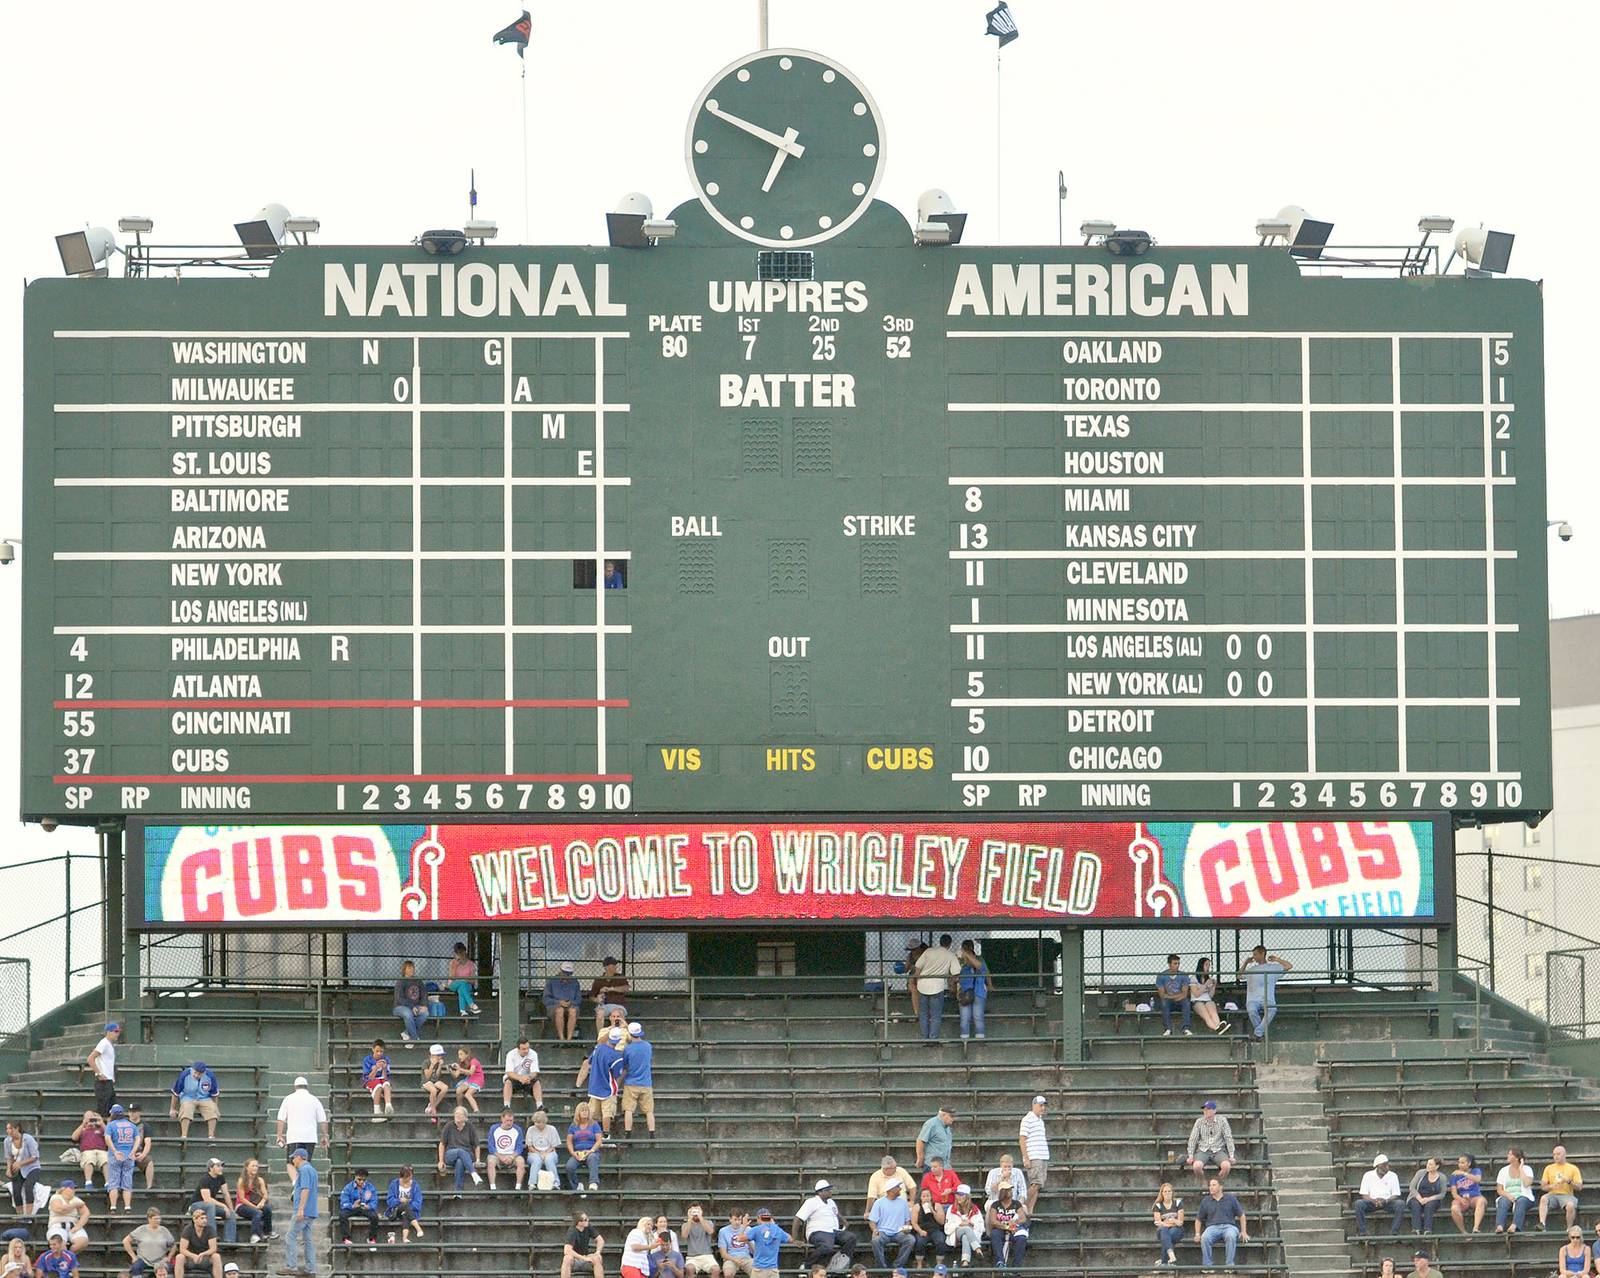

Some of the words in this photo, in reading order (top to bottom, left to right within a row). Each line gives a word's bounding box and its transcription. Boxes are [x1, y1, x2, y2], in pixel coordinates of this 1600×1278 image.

[324, 263, 627, 317] NATIONAL
[708, 280, 869, 313] UMPIRES
[946, 263, 1249, 317] AMERICAN
[648, 314, 702, 333] PLATE
[807, 315, 841, 333] 2ND
[881, 314, 915, 333] 3RD
[172, 341, 307, 365] WASHINGTON
[362, 339, 379, 365] N
[483, 339, 502, 366] G
[661, 334, 688, 358] 80
[742, 334, 757, 361] 7
[811, 334, 836, 361] 25
[885, 335, 912, 359] 52
[1063, 340, 1163, 364] OAKLAND
[1494, 340, 1510, 366] 5
[171, 377, 295, 402] MILWAUKEE
[513, 376, 533, 402] A
[719, 373, 857, 408] BATTER
[1063, 377, 1161, 401] TORONTO
[171, 414, 302, 438] PITTSBURGH
[542, 413, 565, 440] M
[1063, 414, 1130, 438] TEXAS
[1495, 413, 1511, 440] 2
[172, 451, 203, 476] ST.
[208, 451, 272, 475] LOUIS
[577, 450, 593, 476] E
[1064, 451, 1164, 475] HOUSTON
[171, 488, 290, 513] BALTIMORE
[964, 486, 983, 513] 8
[1064, 488, 1130, 512] MIAMI
[171, 525, 267, 550] ARIZONA
[671, 515, 723, 537] BALL
[843, 515, 916, 537] STRIKE
[959, 523, 989, 550] 13
[1065, 524, 1148, 548] KANSAS
[1152, 524, 1197, 548] CITY
[171, 562, 220, 586] NEW
[224, 562, 283, 587] YORK
[1066, 561, 1189, 585] CLEVELAND
[171, 599, 203, 624] LOS
[206, 599, 279, 624] ANGELES
[1066, 597, 1189, 622] MINNESOTA
[69, 636, 89, 662] 4
[171, 637, 301, 661] PHILADELPHIA
[331, 635, 350, 662] R
[768, 635, 811, 658] OUT
[1067, 634, 1098, 659] LOS
[1101, 635, 1174, 659] ANGELES
[65, 673, 94, 699] 12
[171, 674, 263, 698] ATLANTA
[967, 671, 985, 698] 5
[1067, 672, 1112, 696] NEW
[1115, 671, 1170, 696] YORK
[63, 710, 96, 737] 55
[171, 710, 291, 735] CINCINNATI
[967, 708, 986, 735] 5
[1067, 708, 1155, 733] DETROIT
[63, 748, 96, 775] 37
[171, 748, 230, 773] CUBS
[660, 747, 702, 771] VIS
[766, 747, 816, 771] HITS
[866, 747, 934, 771] CUBS
[963, 745, 990, 772] 10
[1068, 746, 1163, 770] CHICAGO
[64, 786, 93, 810] SP
[121, 786, 150, 809] RP
[180, 786, 251, 809] INNING
[362, 784, 380, 811] 2
[393, 784, 411, 811] 3
[422, 784, 442, 810] 4
[454, 783, 473, 810] 5
[485, 783, 504, 810] 6
[516, 784, 533, 810] 7
[547, 783, 566, 810] 8
[577, 783, 596, 810] 9
[605, 783, 631, 810] 10
[962, 783, 991, 807] SP
[1018, 784, 1047, 807] RP
[1081, 783, 1151, 807] INNING
[1258, 782, 1275, 808] 2
[1289, 781, 1307, 808] 3
[1317, 781, 1336, 808] 4
[1349, 781, 1367, 808] 5
[1379, 781, 1398, 808] 6
[1410, 781, 1427, 808] 7
[1439, 781, 1458, 808] 8
[1469, 781, 1488, 808] 9
[1496, 781, 1523, 808] 10
[180, 835, 381, 920] CUBS
[470, 835, 692, 916] WELCOME
[701, 831, 757, 896] TO
[771, 830, 969, 900] WRIGLEY
[978, 840, 1101, 915] FIELD
[1199, 822, 1401, 916] CUBS
